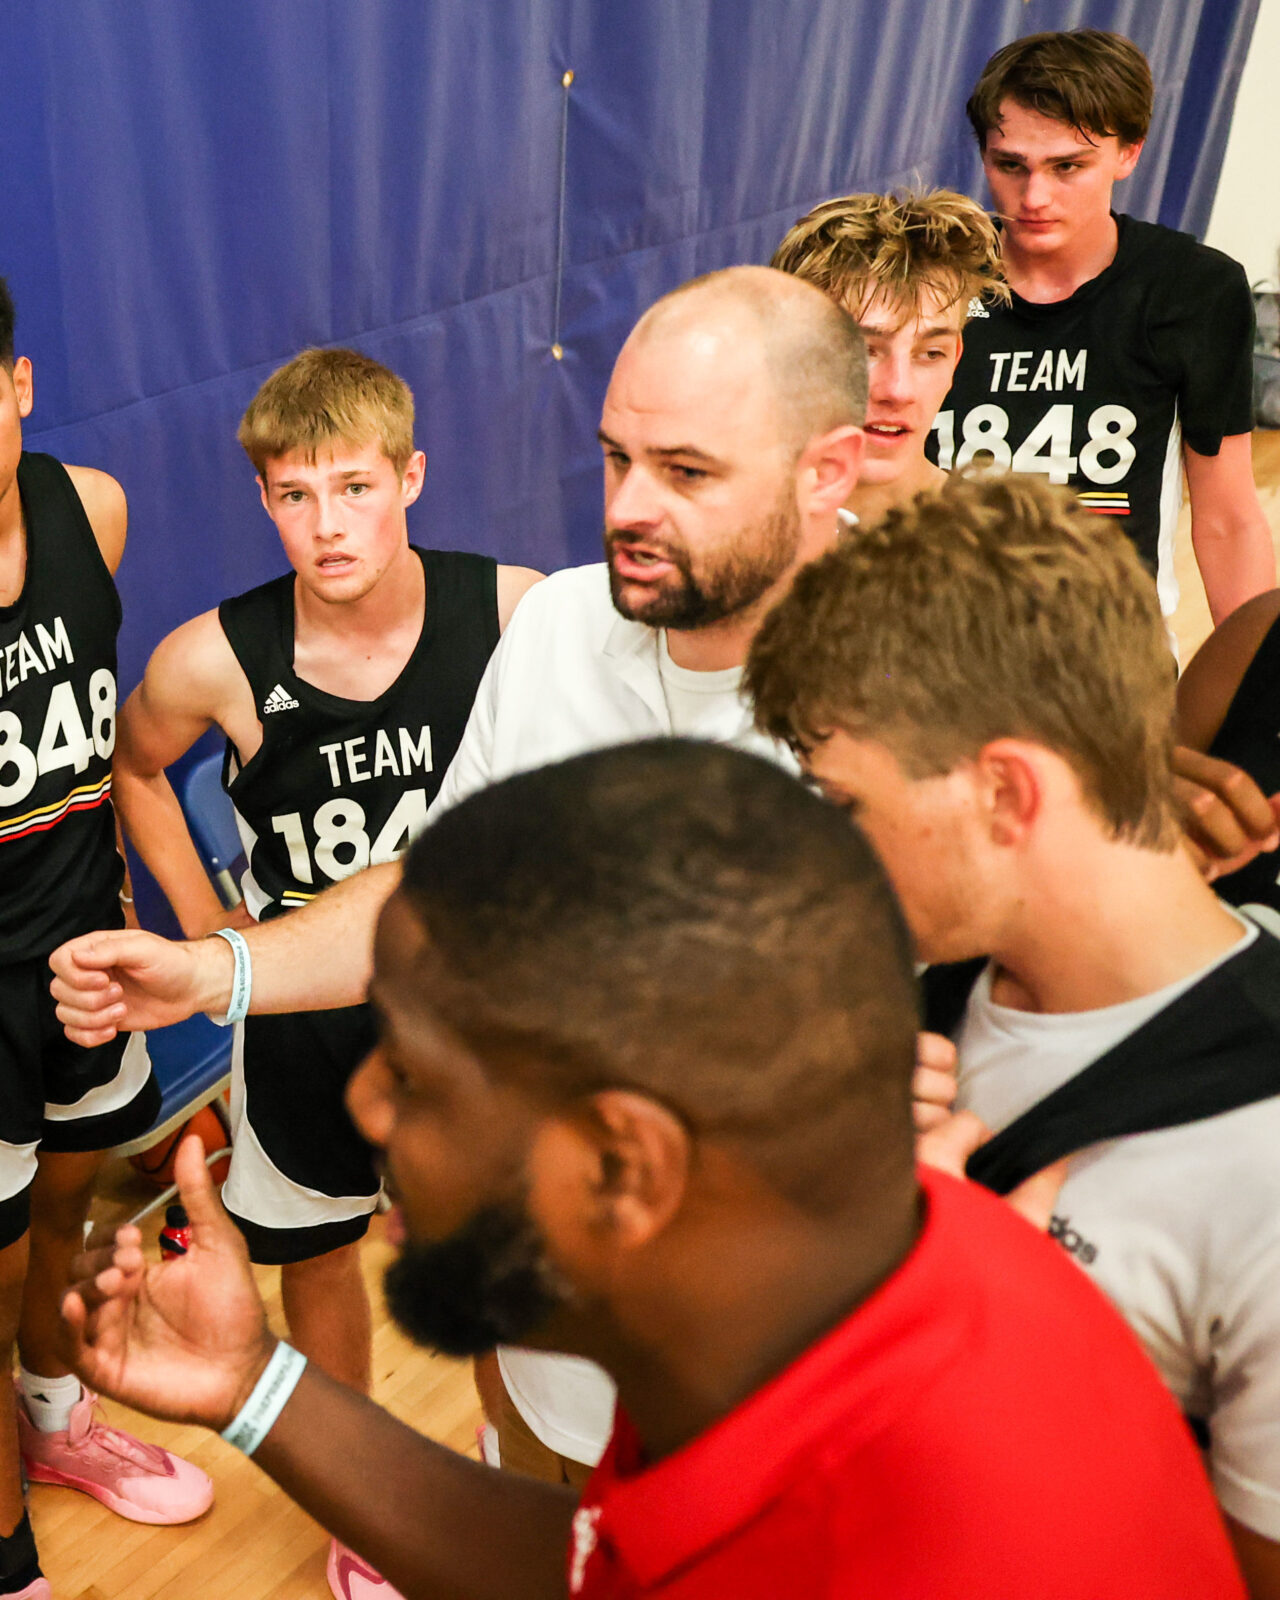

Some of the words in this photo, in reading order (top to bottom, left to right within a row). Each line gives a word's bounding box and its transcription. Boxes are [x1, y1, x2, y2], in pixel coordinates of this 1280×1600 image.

[989, 349, 1088, 392] TEAM
[930, 404, 1137, 485] 1848
[263, 699, 300, 715] adidas
[319, 725, 433, 788] TEAM
[271, 788, 431, 884] 184
